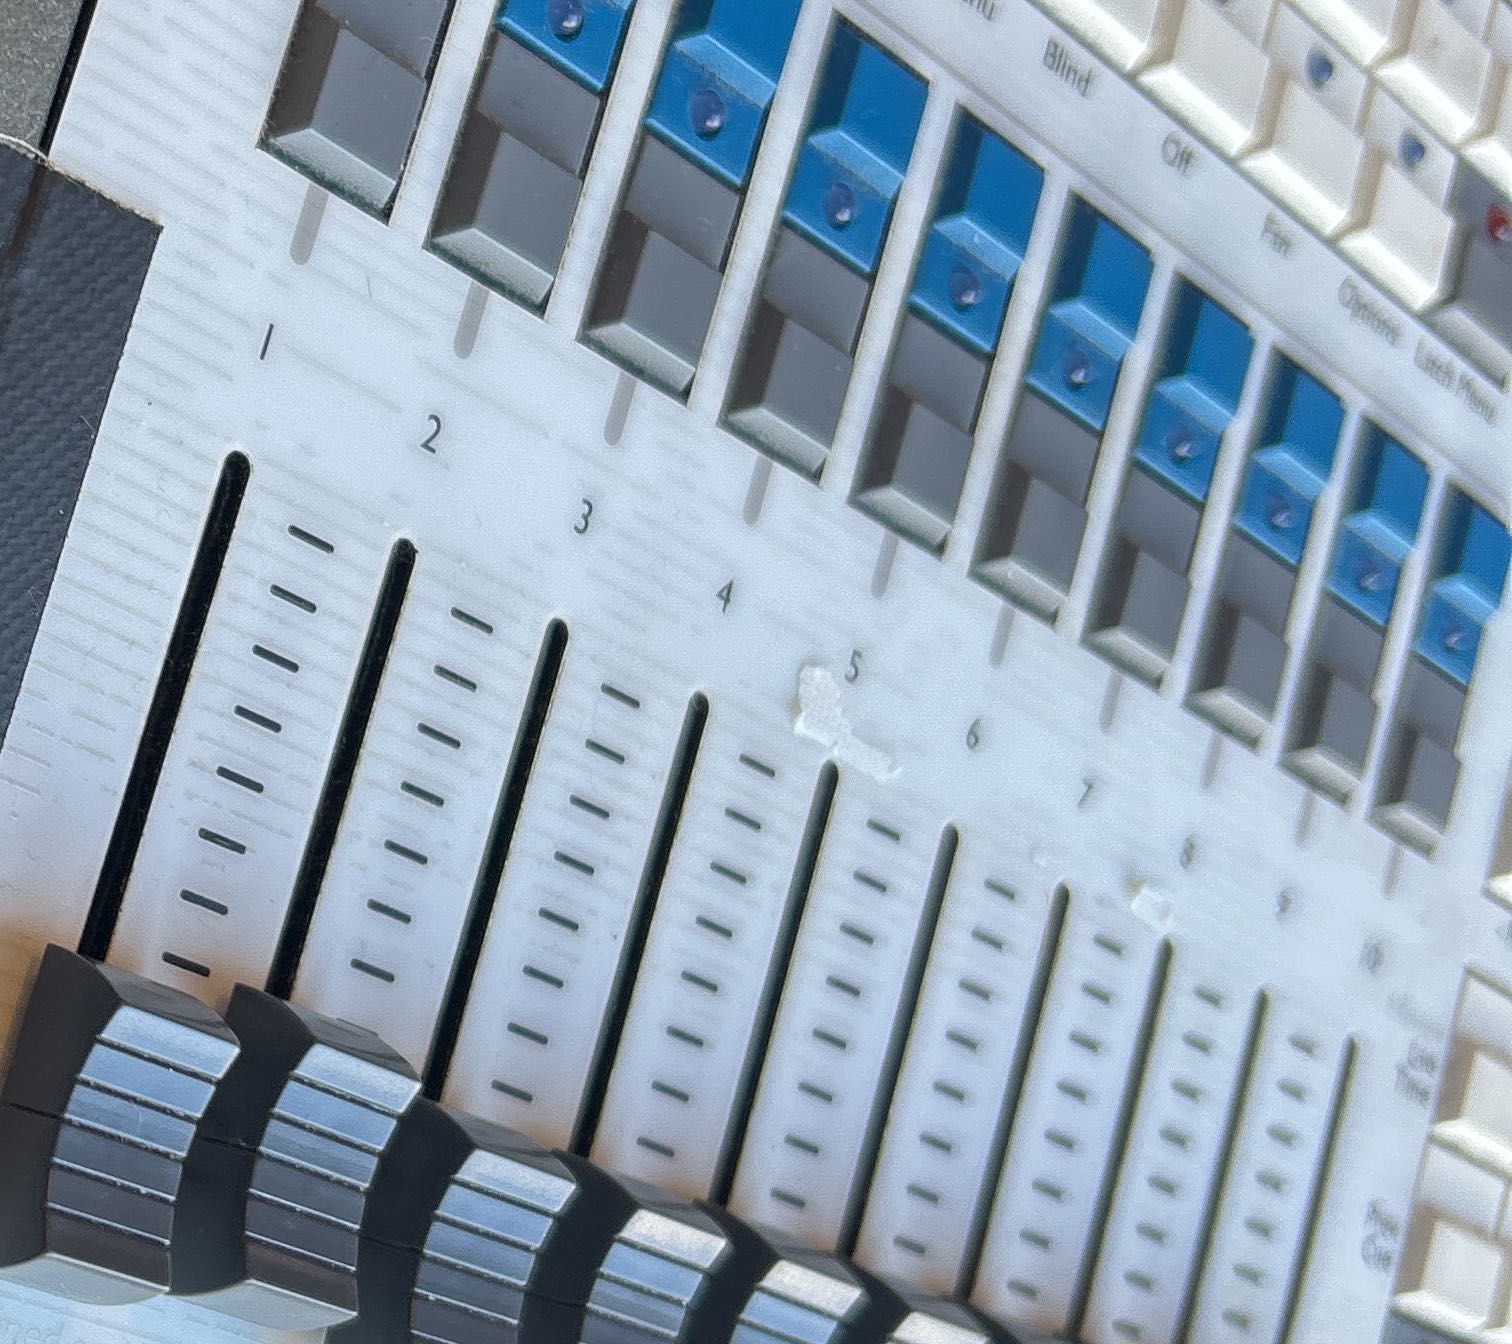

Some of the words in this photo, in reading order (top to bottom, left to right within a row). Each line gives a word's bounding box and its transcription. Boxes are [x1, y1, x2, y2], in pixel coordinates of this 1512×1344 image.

[420, 412, 443, 455] 2
[573, 497, 595, 535] 3
[715, 579, 735, 614] 4
[844, 648, 863, 684] 5
[965, 716, 983, 752] 6
